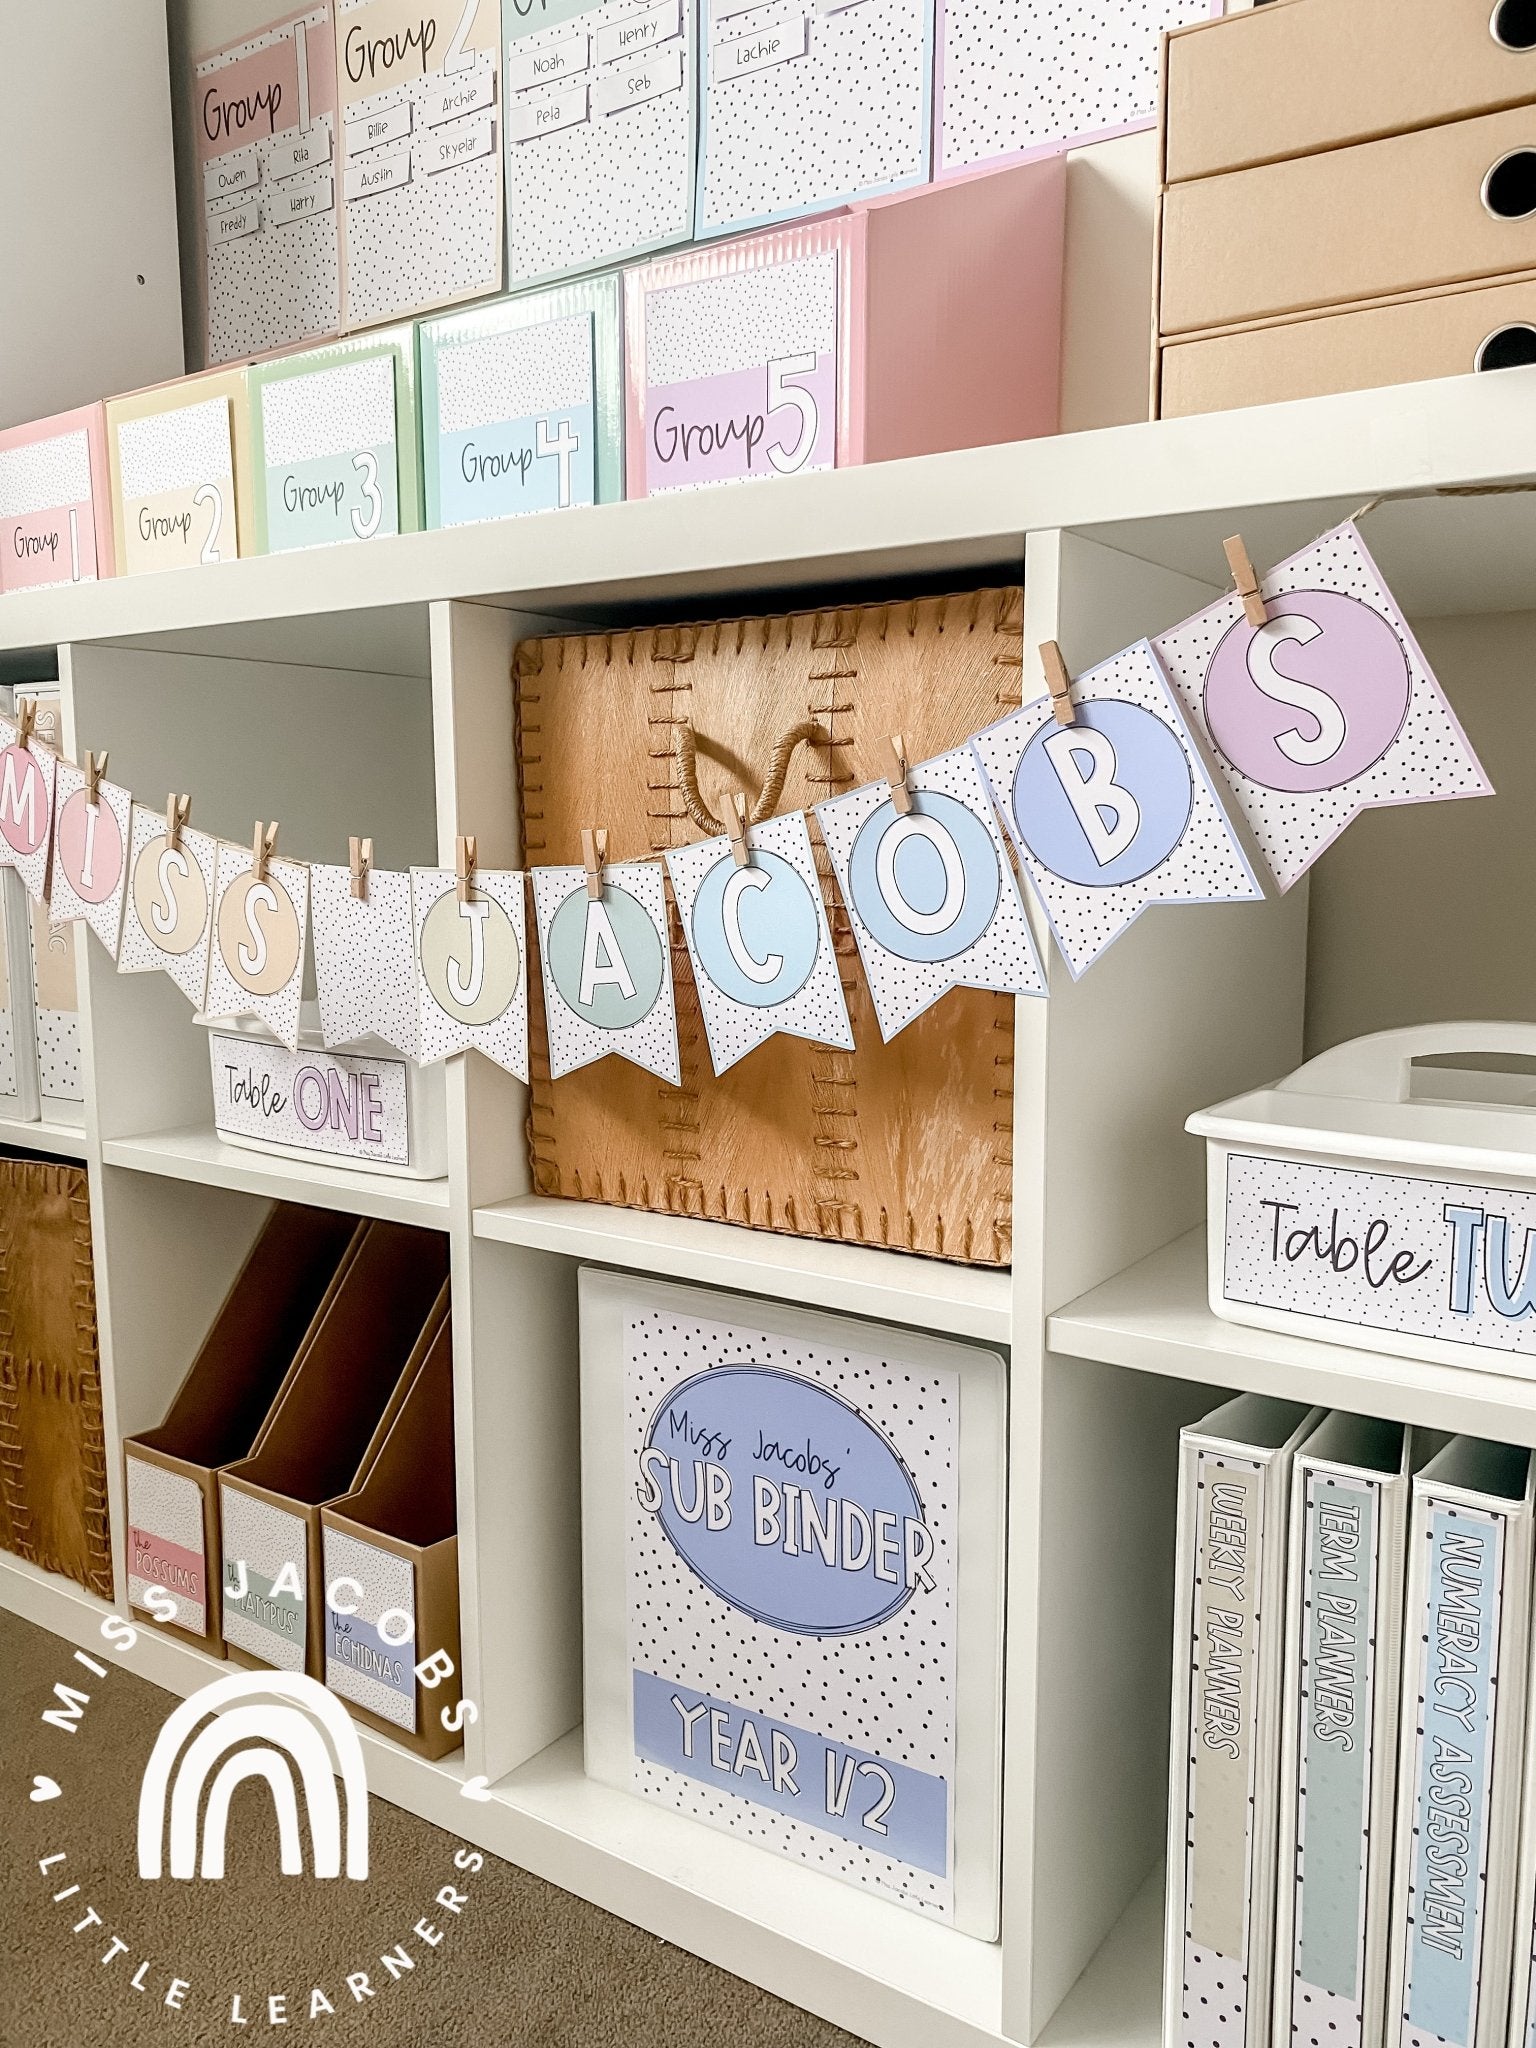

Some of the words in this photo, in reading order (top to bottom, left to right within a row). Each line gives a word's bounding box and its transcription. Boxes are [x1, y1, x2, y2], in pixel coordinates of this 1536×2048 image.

[345, 18, 436, 83] Group
[533, 53, 565, 75] Noah
[619, 20, 658, 48] Henry
[736, 38, 781, 65] Lachie
[203, 83, 282, 141] Group
[294, 21, 311, 135] 1
[442, 87, 478, 112] Archie
[627, 70, 651, 95] Seb
[293, 147, 309, 164] Rita
[367, 120, 389, 140] Billie
[439, 135, 477, 161] Skyelar
[218, 169, 247, 188] Owen
[290, 194, 316, 212] Harry
[360, 168, 393, 188] Austin
[220, 214, 247, 234] Freddy
[653, 406, 765, 469] Group
[766, 351, 818, 474] 5
[283, 475, 344, 516] Group
[351, 451, 383, 540] 3
[461, 442, 533, 487] Group
[536, 419, 579, 509] 4
[14, 526, 59, 561] Group
[69, 508, 80, 581] 1
[139, 507, 191, 544] Group
[193, 484, 223, 564] 2
[446, 613, 1346, 1007] JACOBS
[224, 1064, 288, 1117] Table
[293, 1066, 383, 1143] ONE
[1260, 1200, 1432, 1288] Table
[669, 1409, 732, 1461] Miss
[753, 1430, 851, 1490] Jacobs'
[133, 1530, 152, 1550] the
[636, 1446, 733, 1532] SUB
[753, 1474, 938, 1596] BINDER
[1206, 1480, 1248, 1602] WEEKLY
[1317, 1500, 1362, 1582] TERM
[136, 1549, 199, 1595] POSSUMS
[331, 1611, 353, 1634] the
[335, 1631, 404, 1686] ECHIDNAS
[1433, 1529, 1486, 1734] NUMERACY
[1202, 1604, 1245, 1761] PLANNERS
[1312, 1589, 1358, 1754] PLANNERS
[670, 1694, 801, 1799] YEAR
[1420, 1734, 1474, 1961] ASSESSMENT
